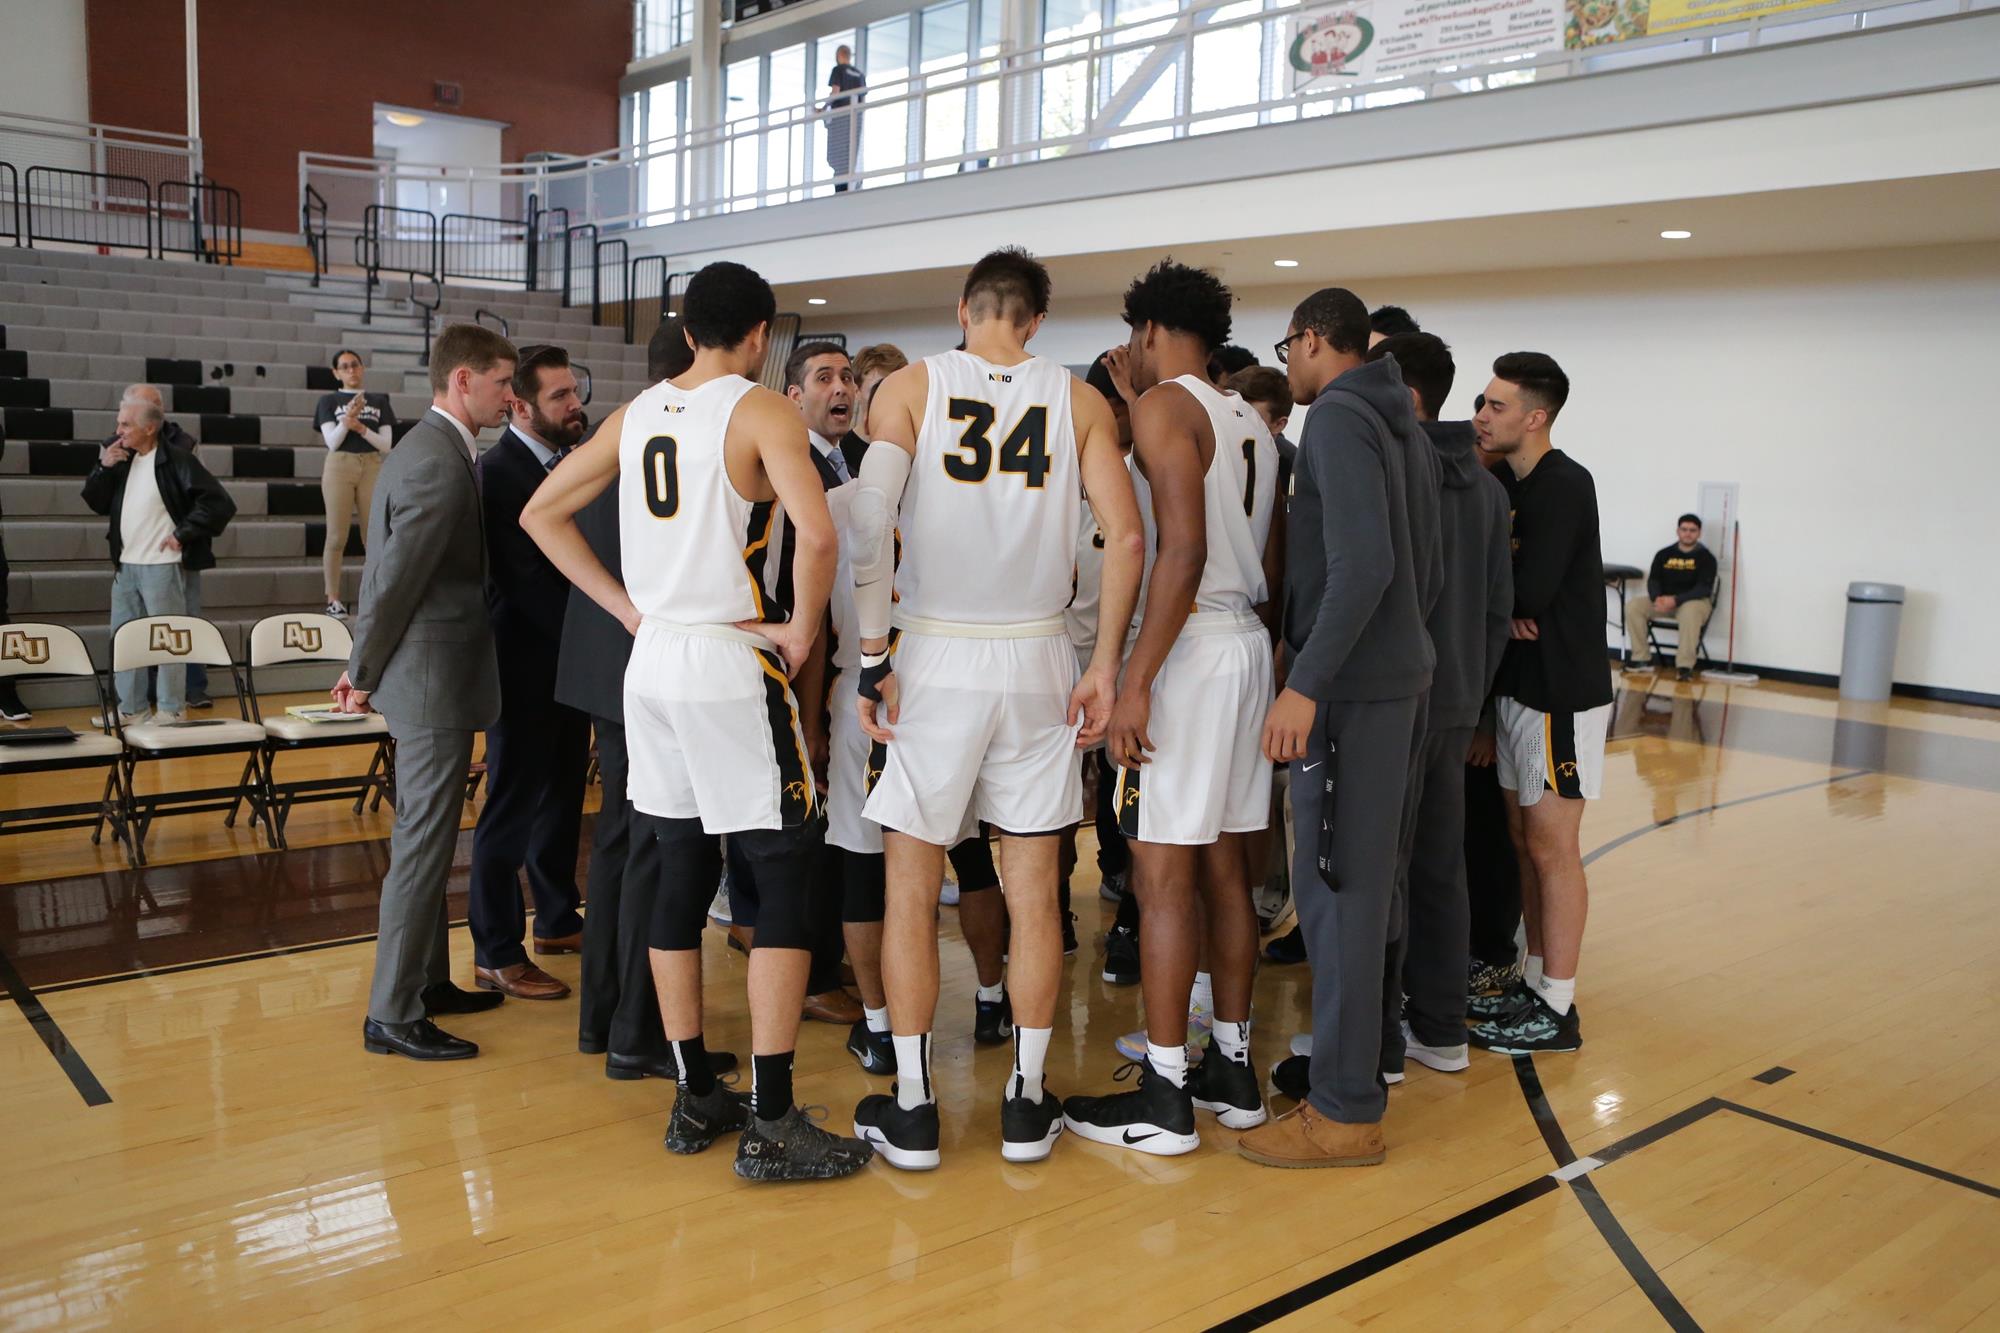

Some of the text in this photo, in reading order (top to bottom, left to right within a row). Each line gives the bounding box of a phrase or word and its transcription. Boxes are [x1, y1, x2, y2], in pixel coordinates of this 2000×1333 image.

[942, 396, 1054, 489] 34
[643, 433, 681, 521] 0
[1241, 436, 1257, 519] 1
[1, 630, 50, 665] AU
[150, 623, 193, 656] AU
[284, 621, 322, 653] AU
